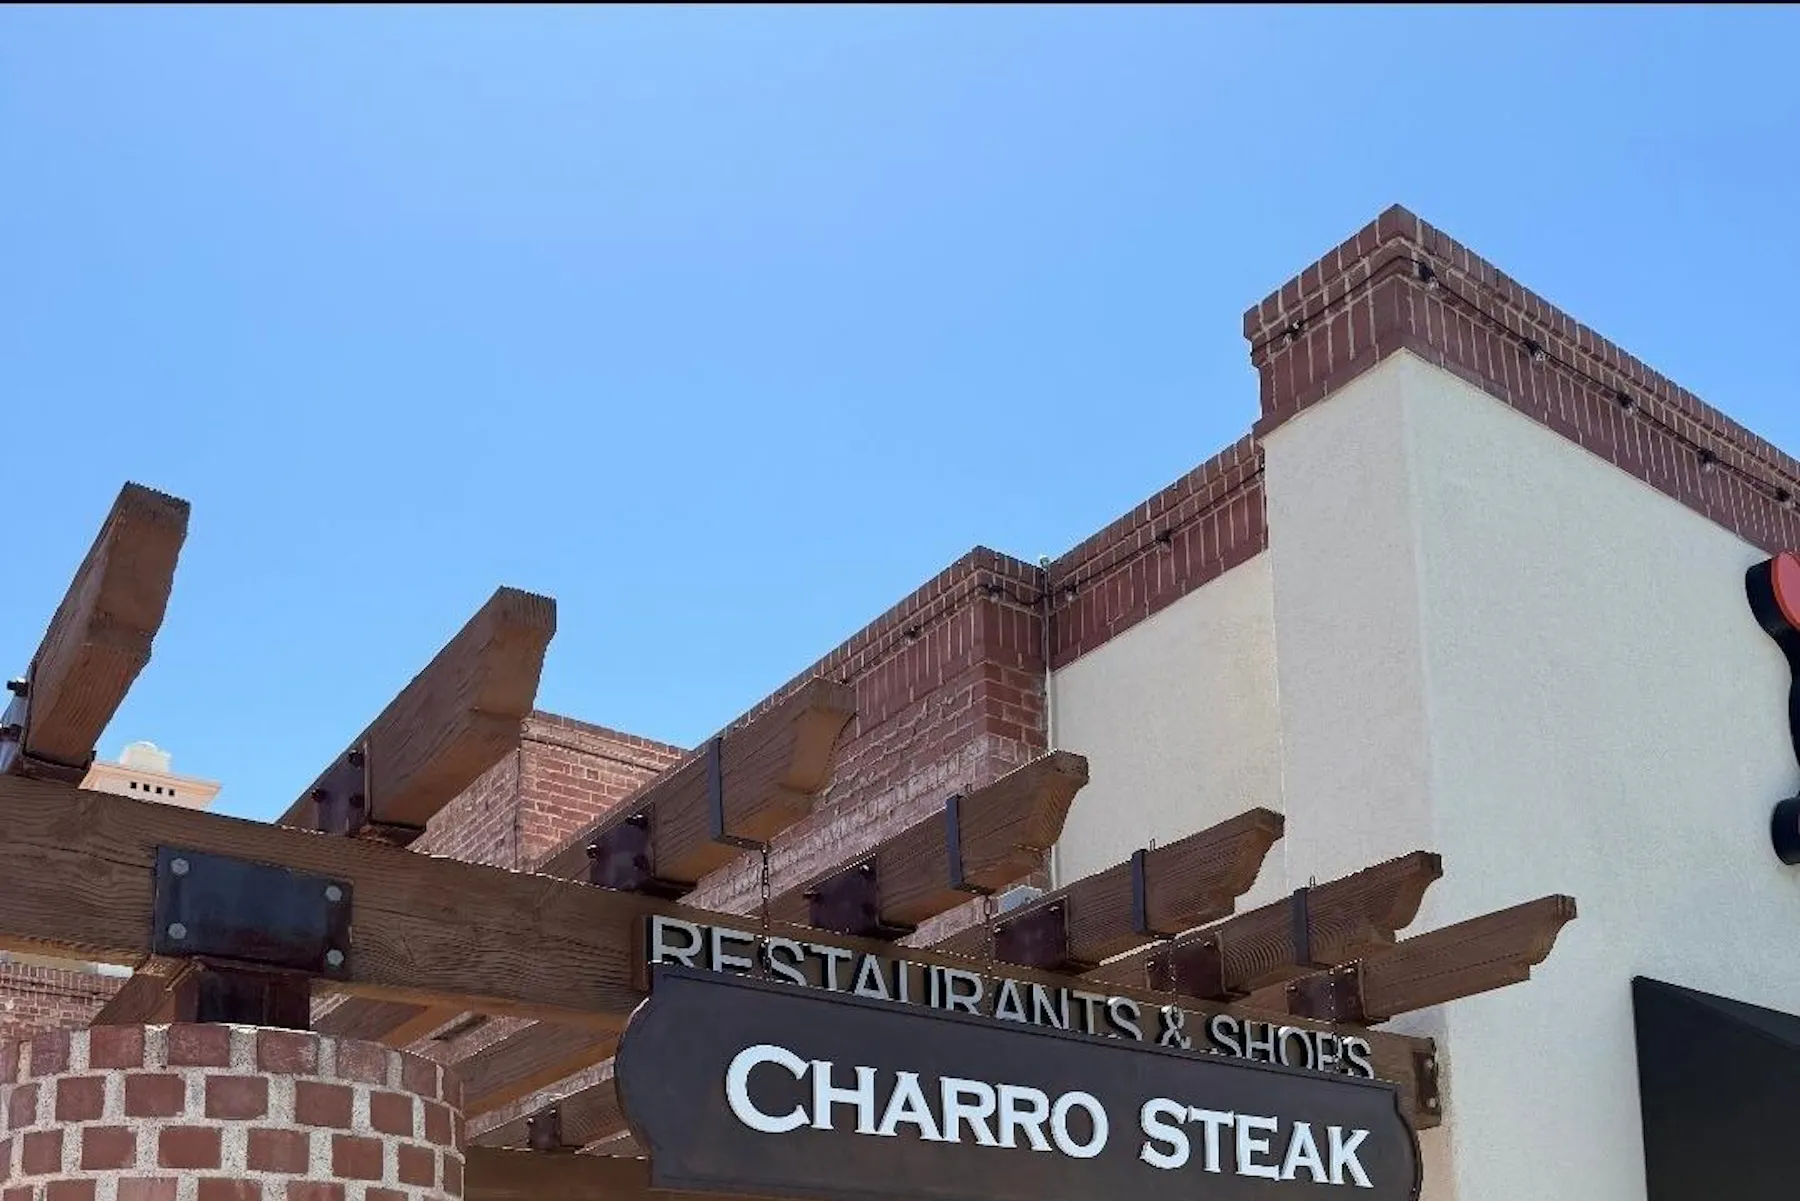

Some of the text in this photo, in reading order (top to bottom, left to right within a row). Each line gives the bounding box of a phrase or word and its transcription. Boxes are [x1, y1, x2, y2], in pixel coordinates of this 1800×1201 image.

[652, 914, 1375, 1079] RESTAURANTS & SHOPS
[725, 1044, 1374, 1188] CHARRO STEAK
